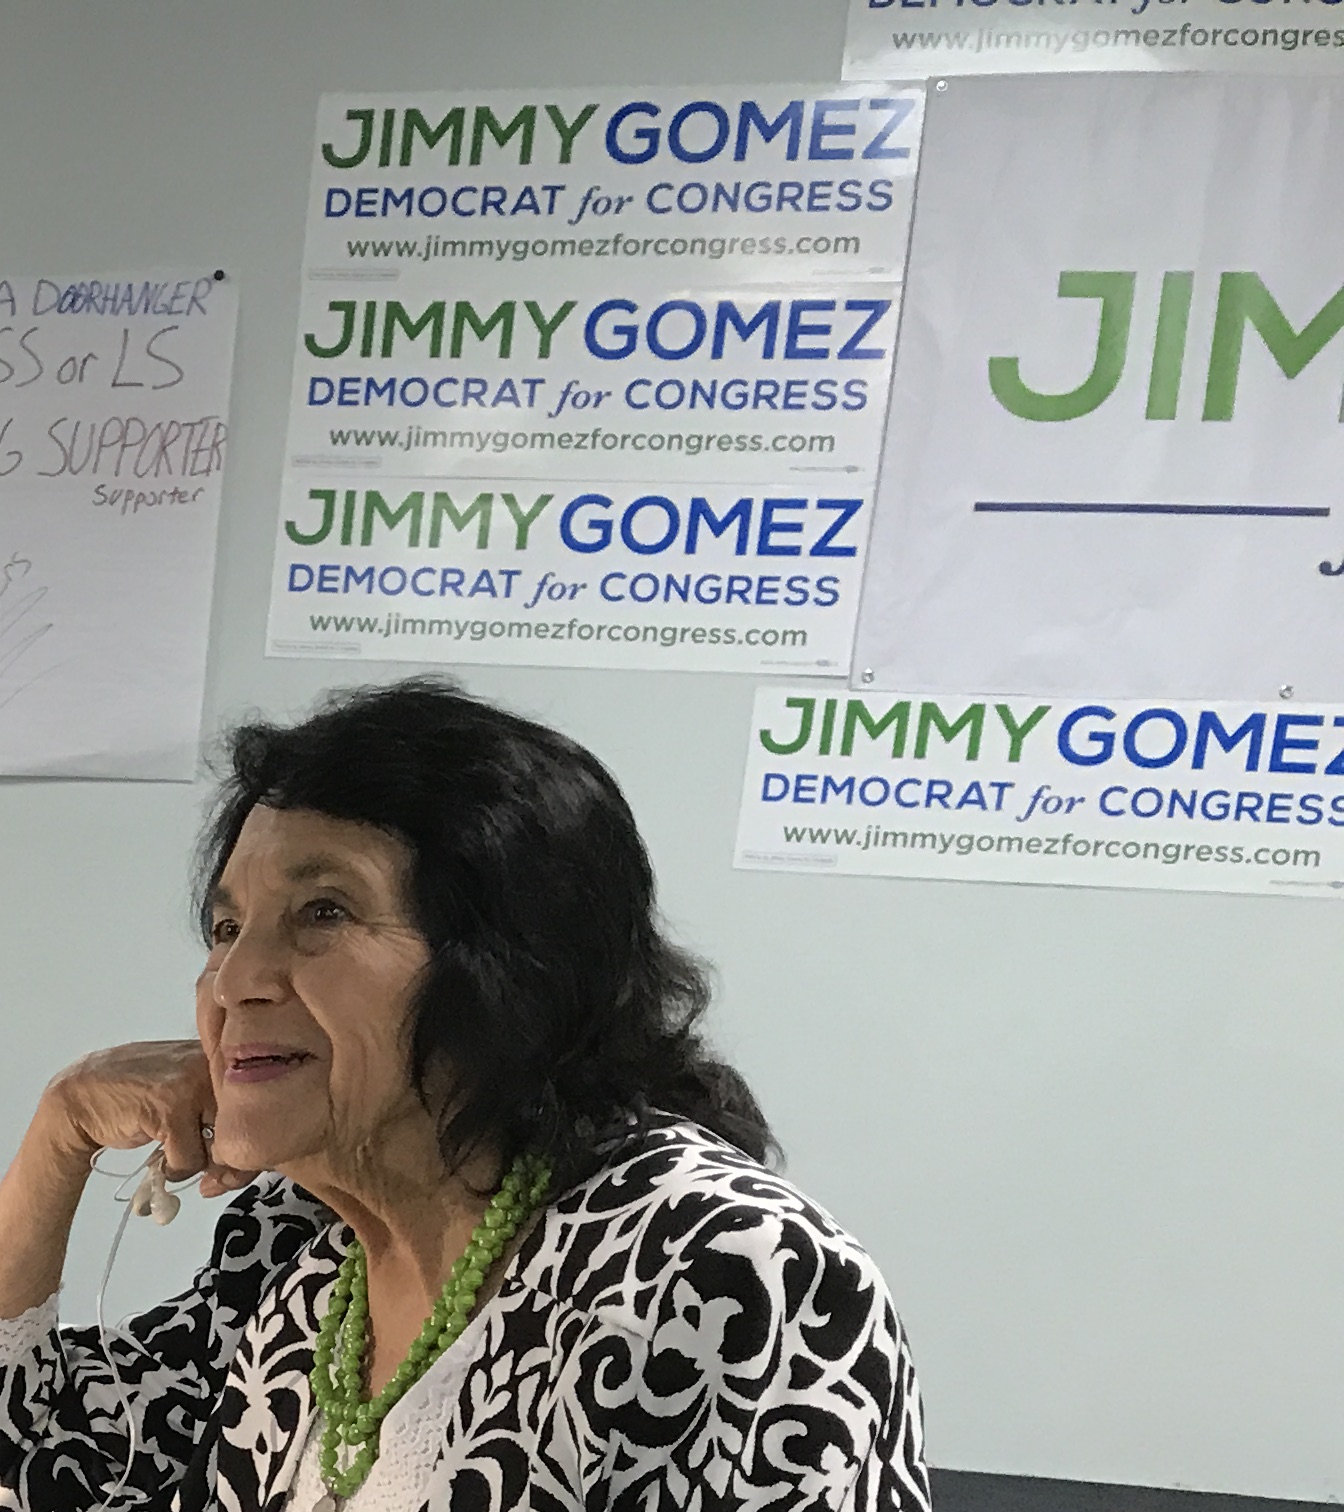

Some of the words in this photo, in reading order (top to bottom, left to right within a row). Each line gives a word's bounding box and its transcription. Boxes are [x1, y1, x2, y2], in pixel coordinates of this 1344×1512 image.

[321, 102, 600, 169] JIMMY
[604, 99, 912, 164] GOMEZ
[324, 185, 566, 218] DEMOCRAT
[568, 186, 635, 225] for
[645, 179, 894, 215] CONGRESS
[347, 231, 861, 261] www.jimmygomezforcongress.com
[303, 300, 578, 360] JIMMY
[583, 299, 893, 361] GOMEZ
[988, 270, 1344, 423] JIM
[57, 352, 99, 384] or
[111, 325, 185, 390] LS
[307, 376, 546, 409] DEMOCRAT
[547, 378, 613, 419] for
[624, 378, 869, 412] CONGRESS
[36, 416, 228, 478] SUPPORTER
[329, 426, 836, 455] www.jimmygomezforcongress.com
[284, 488, 555, 550] JIMMY
[559, 492, 865, 558] GOMEZ
[287, 563, 522, 600] DEMOCRAT
[523, 571, 587, 610] for
[599, 571, 841, 607] CONGRESS
[309, 613, 808, 648] www.jimmygomezforcongress.com
[759, 697, 1052, 763] JIMMY
[761, 773, 1014, 811] DEMOCRAT
[1016, 784, 1085, 822] for
[784, 824, 1321, 868] www.jimmygomezforcongress.com
